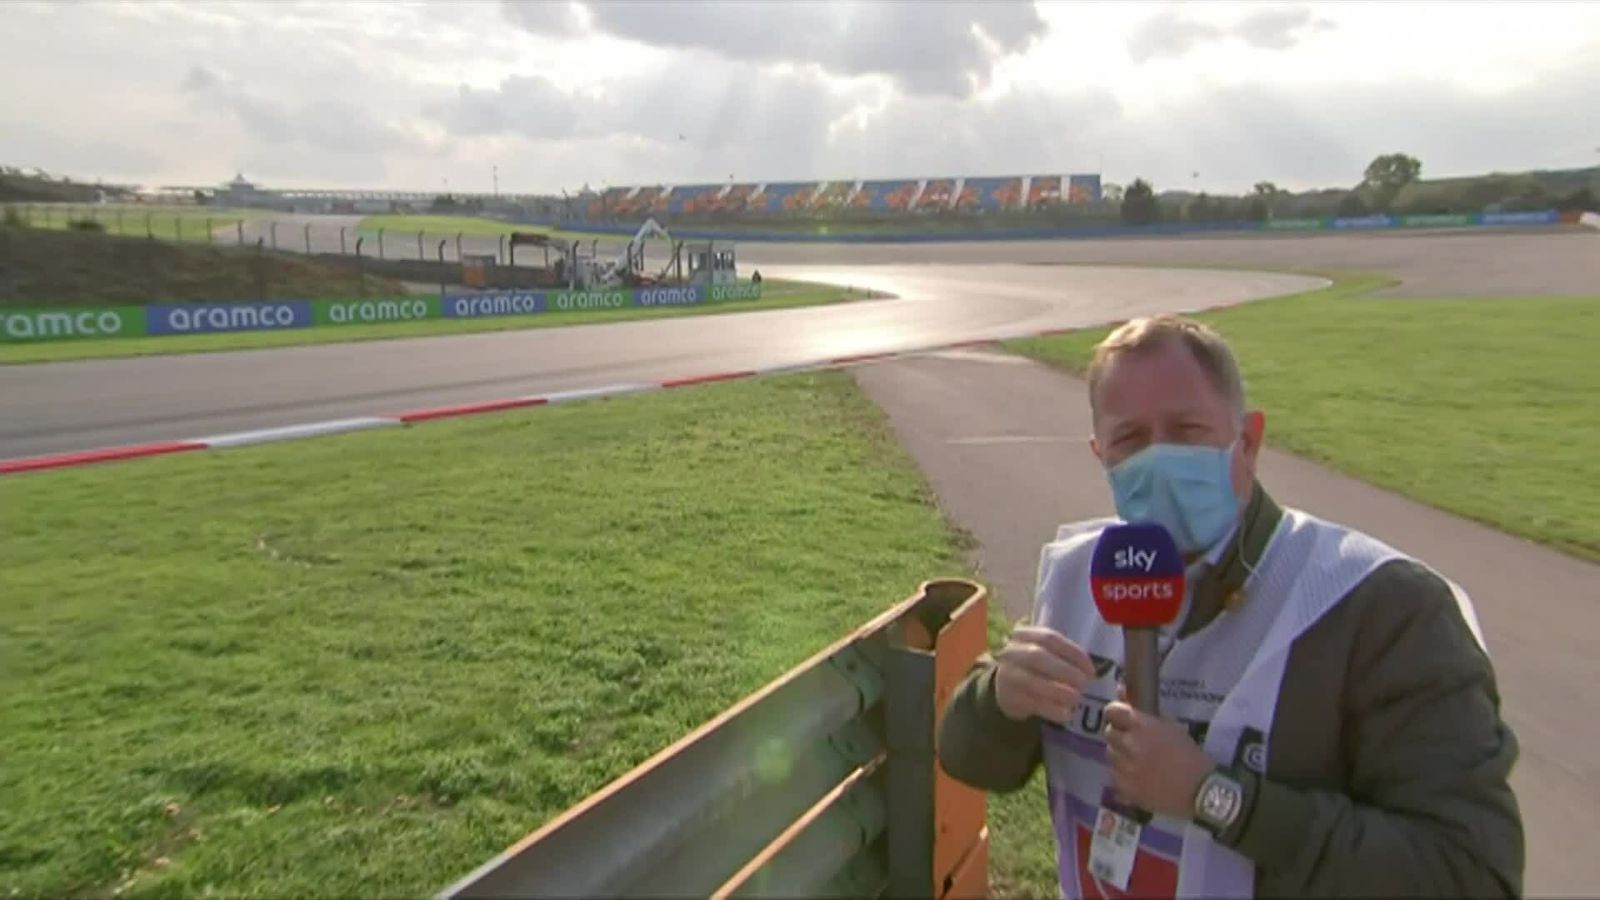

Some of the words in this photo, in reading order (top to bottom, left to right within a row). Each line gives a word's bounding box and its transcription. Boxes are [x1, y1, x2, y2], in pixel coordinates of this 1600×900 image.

[556, 290, 623, 310] aramco
[640, 287, 697, 306] aramco
[712, 285, 759, 300] aramco
[329, 300, 427, 322] aramco
[455, 294, 535, 316] aramco
[0, 311, 122, 337] amco
[169, 305, 294, 331] aramco
[1114, 545, 1157, 571] sky
[1102, 581, 1173, 602] sports
